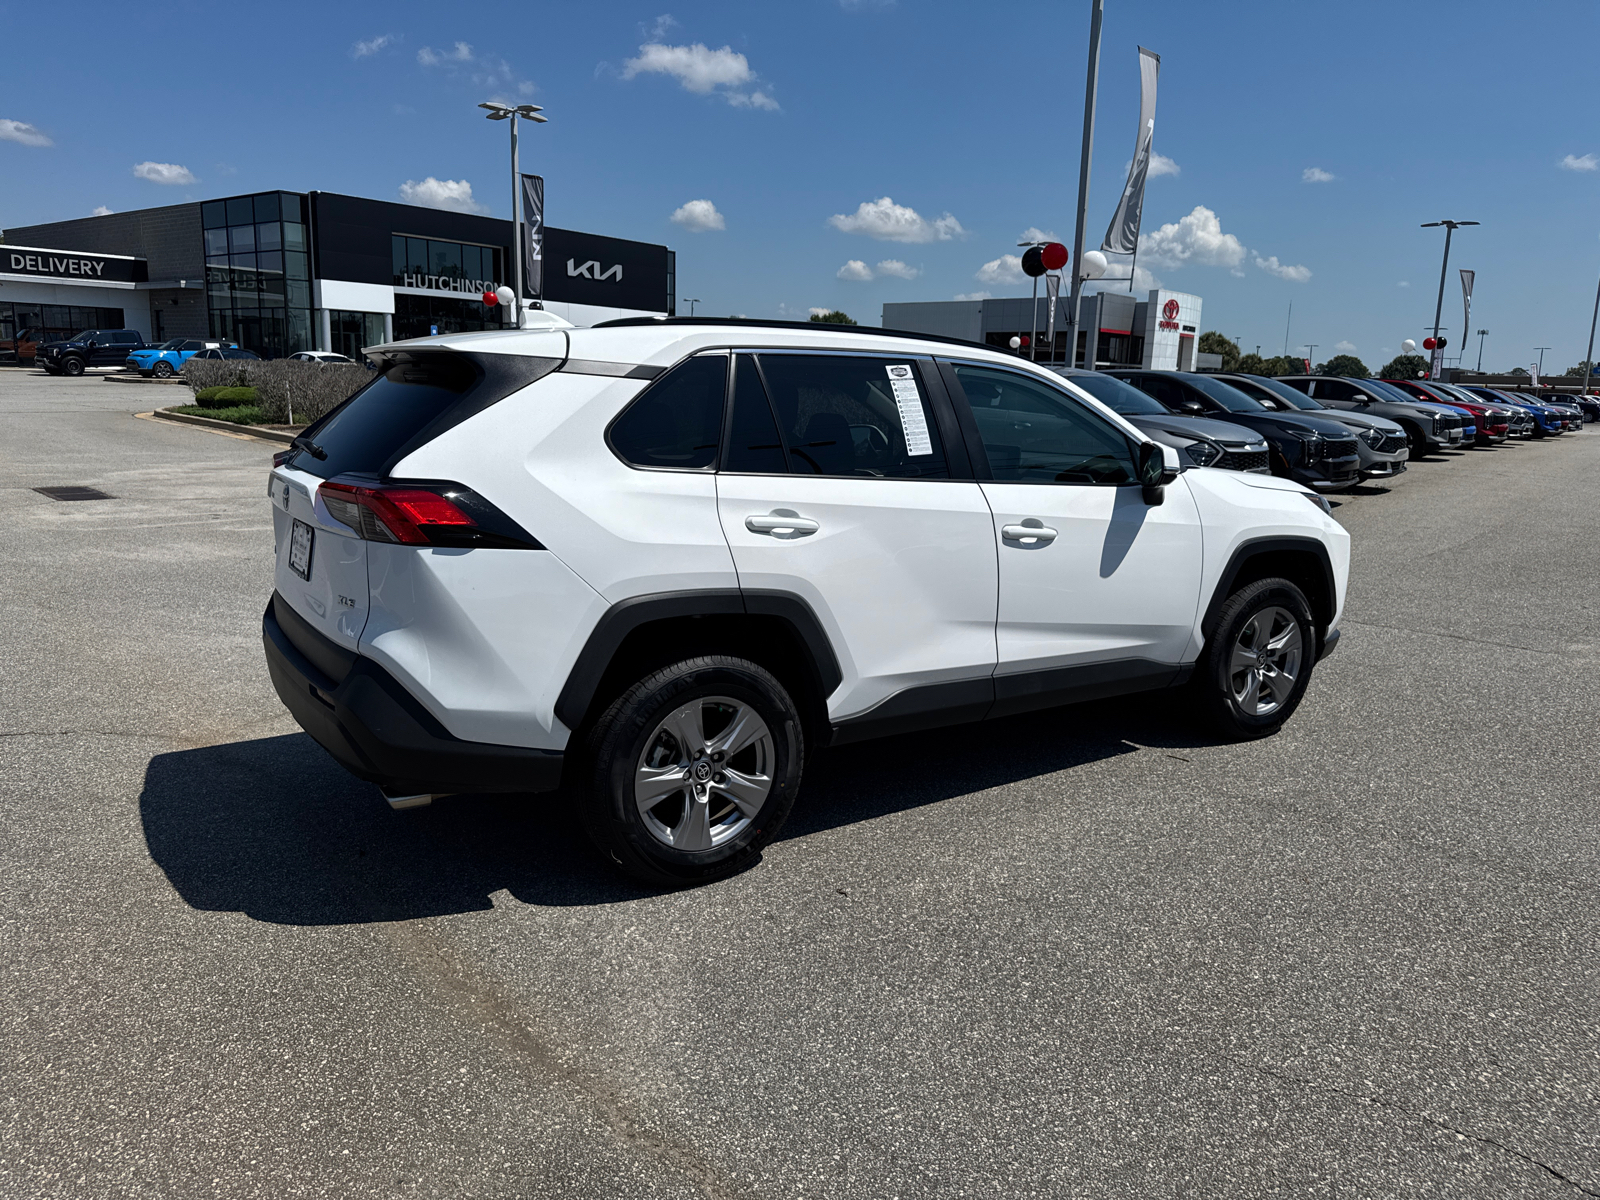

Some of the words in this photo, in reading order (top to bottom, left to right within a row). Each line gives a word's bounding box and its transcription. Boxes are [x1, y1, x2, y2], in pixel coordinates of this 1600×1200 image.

[10, 253, 105, 276] DELIVERY
[566, 257, 623, 283] KIA
[626, 673, 699, 738] OMNIMAX
